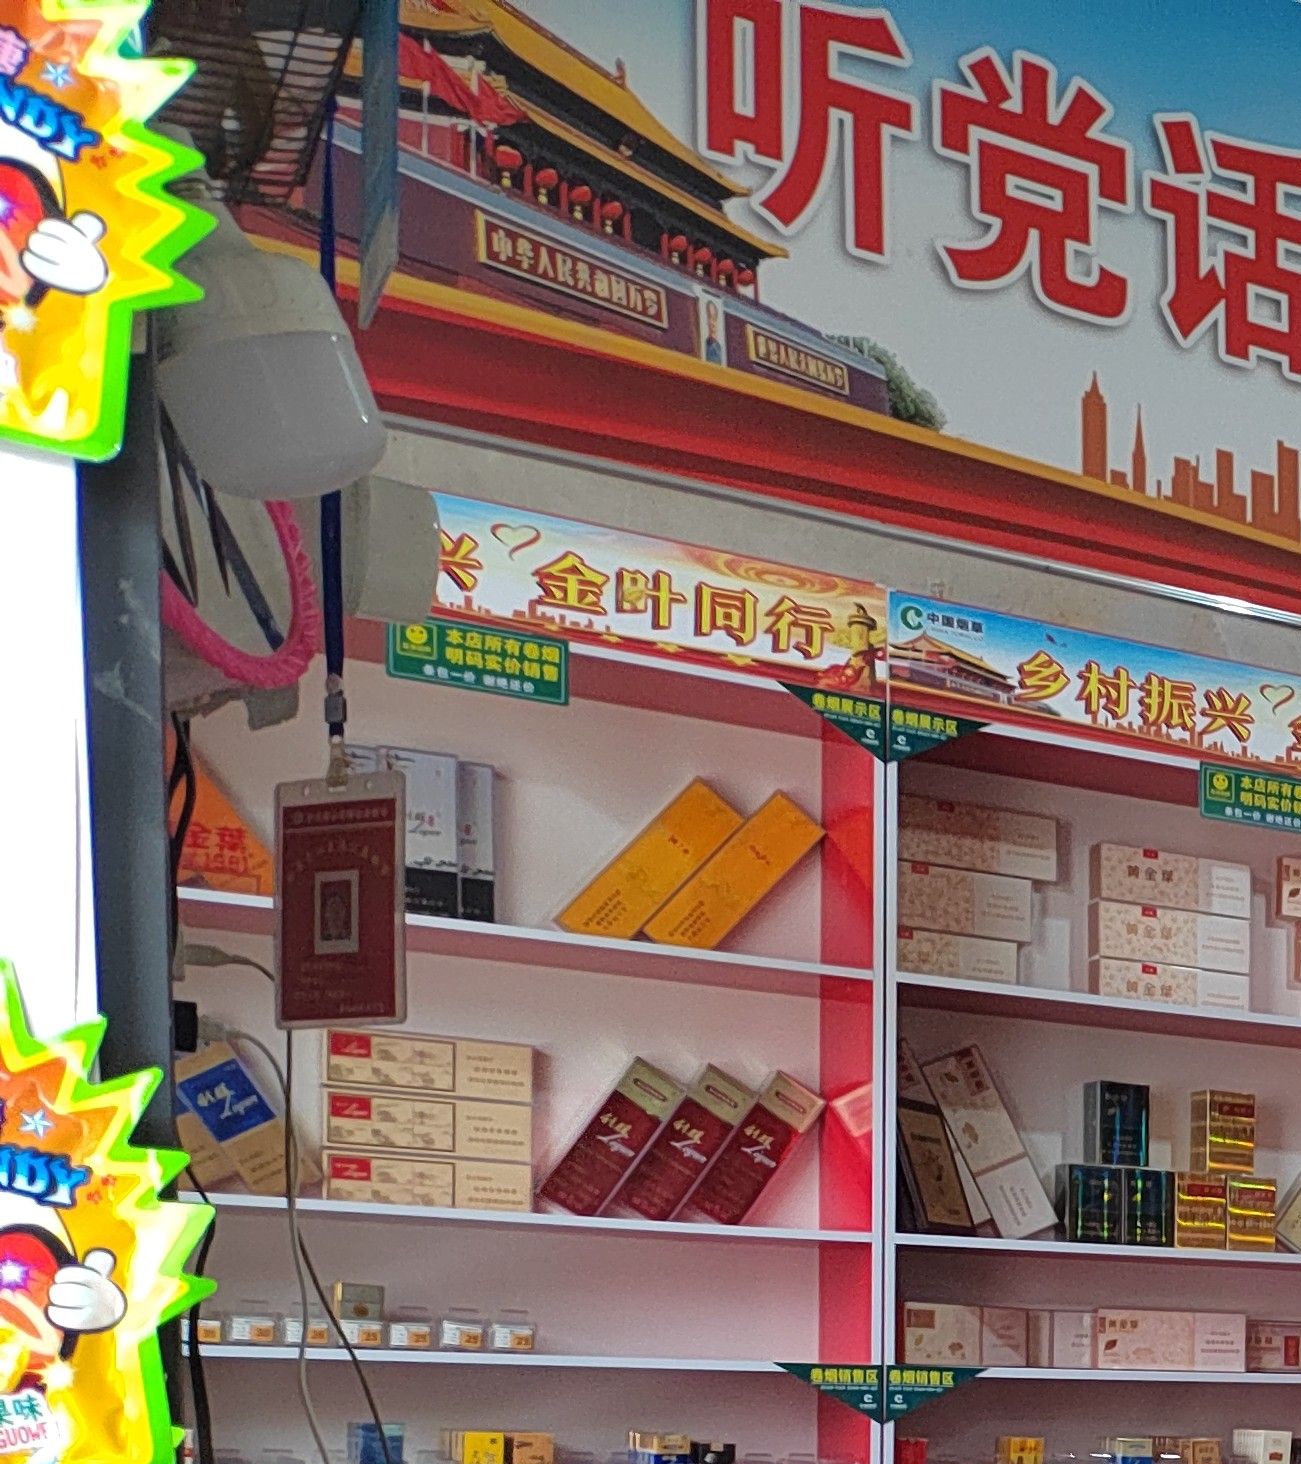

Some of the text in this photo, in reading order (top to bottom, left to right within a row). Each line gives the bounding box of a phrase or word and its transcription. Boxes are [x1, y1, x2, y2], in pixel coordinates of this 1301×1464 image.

[533, 551, 834, 660] 金叶同行
[445, 628, 560, 664] 本店所有卷烟
[445, 646, 559, 682] 明码实价销售
[1015, 650, 1258, 743] 乡村振兴
